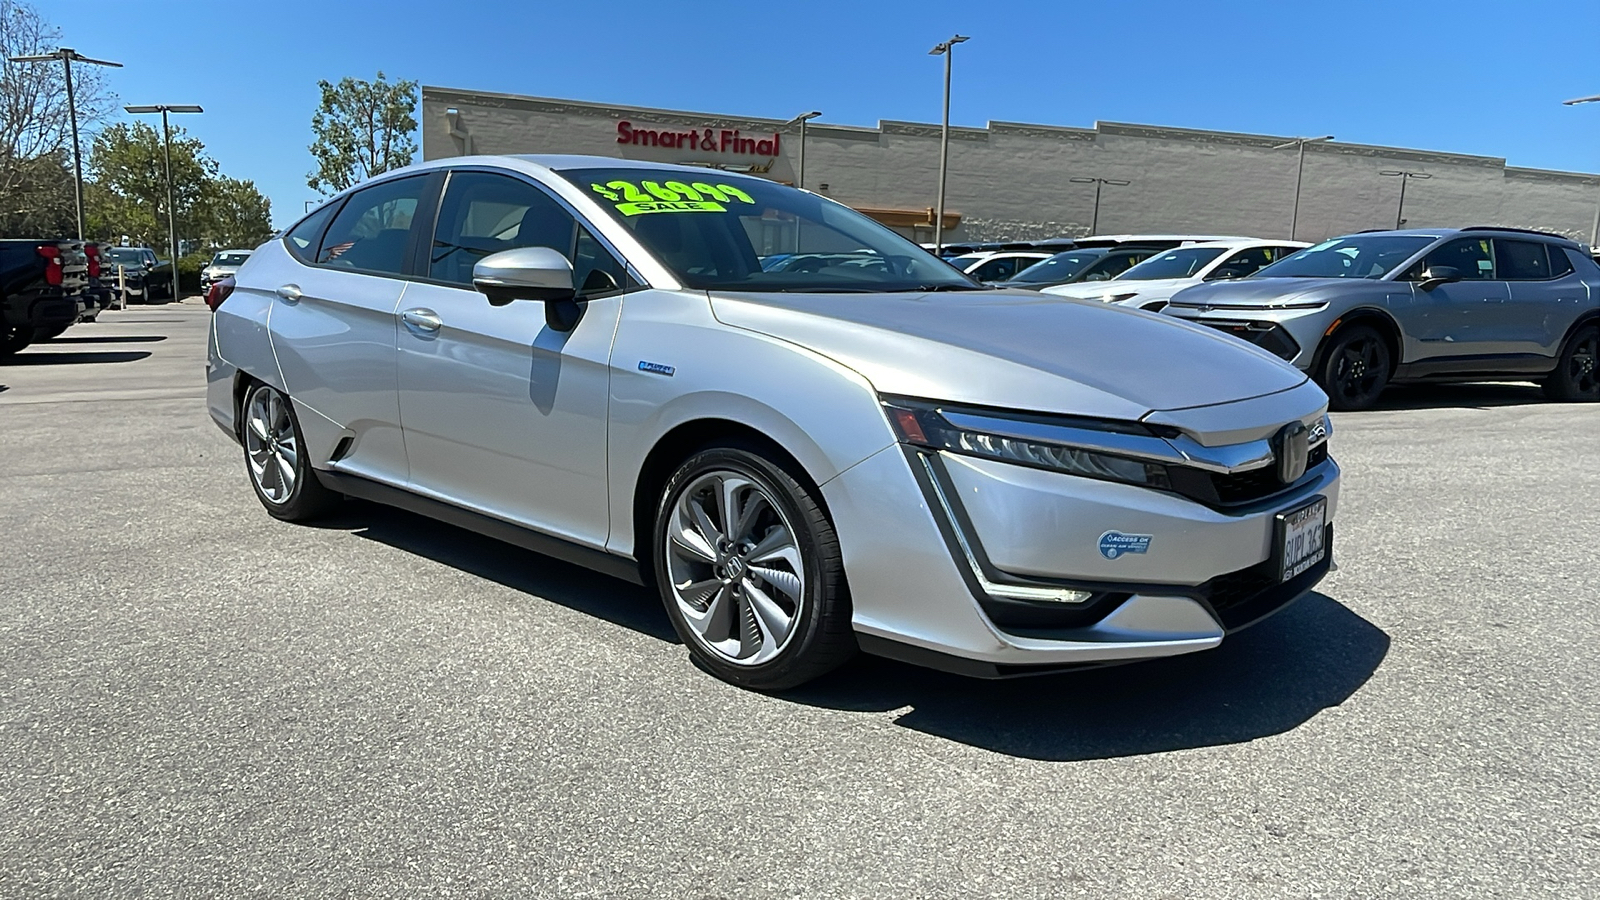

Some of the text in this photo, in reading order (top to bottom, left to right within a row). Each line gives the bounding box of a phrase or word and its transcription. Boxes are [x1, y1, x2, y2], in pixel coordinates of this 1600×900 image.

[617, 121, 780, 157] Smart&Final
[591, 180, 756, 204] $26999
[635, 201, 703, 211] SALE
